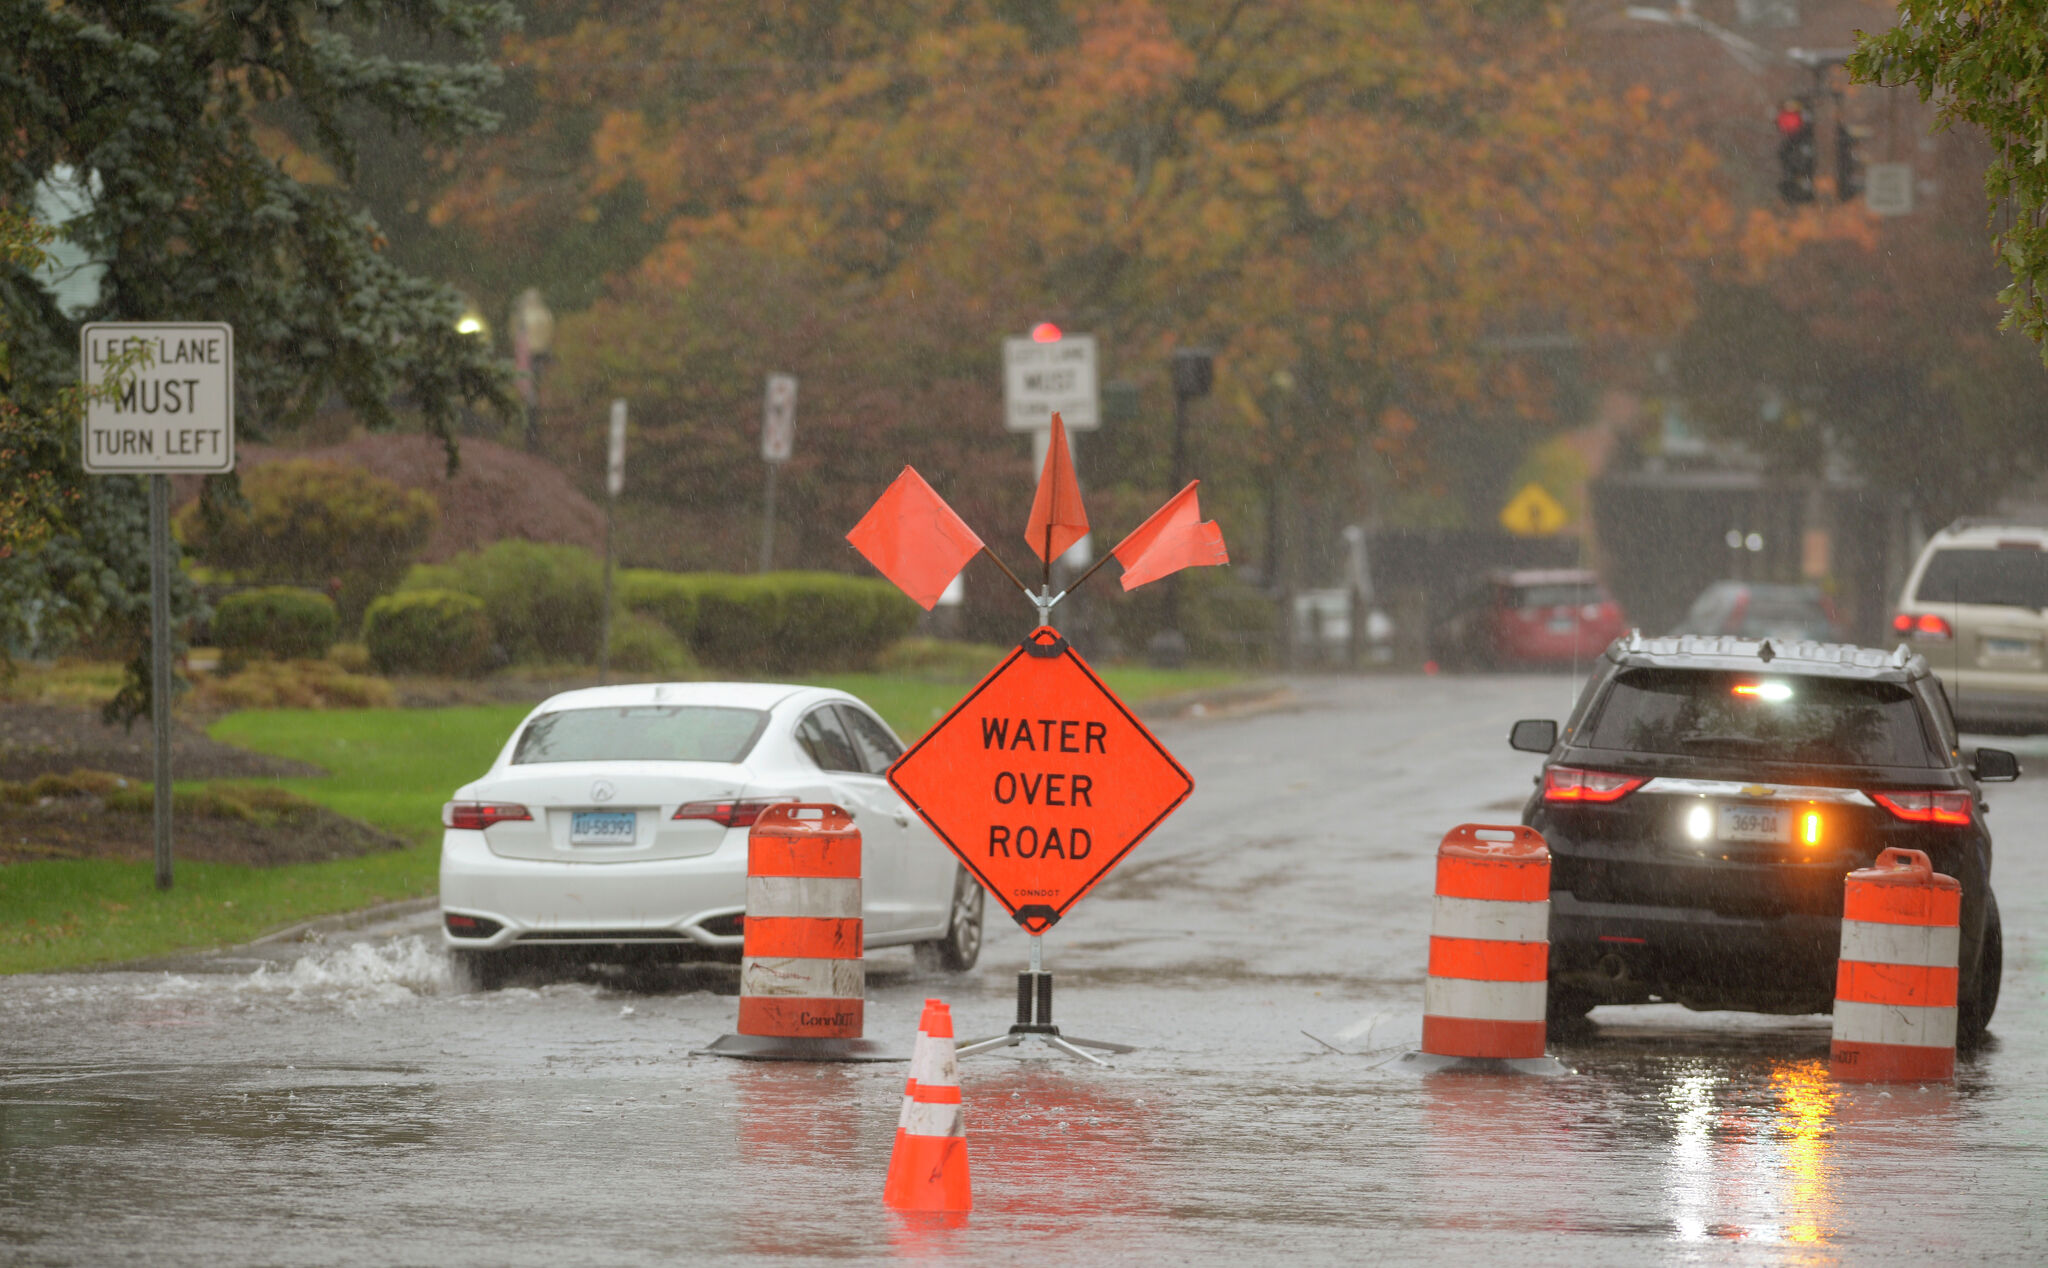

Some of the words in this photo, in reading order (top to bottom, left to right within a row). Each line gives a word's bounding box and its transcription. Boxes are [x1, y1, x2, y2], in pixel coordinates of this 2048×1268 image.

[160, 338, 221, 364] LANE
[114, 378, 200, 415] MUST
[93, 429, 154, 455] TURN
[165, 429, 222, 455] LEFT
[981, 717, 1107, 754] WATER
[994, 771, 1093, 807] OVER
[573, 820, 633, 835] AU-58393
[989, 825, 1092, 860] ROAD
[1013, 889, 1061, 897] CONNDOT
